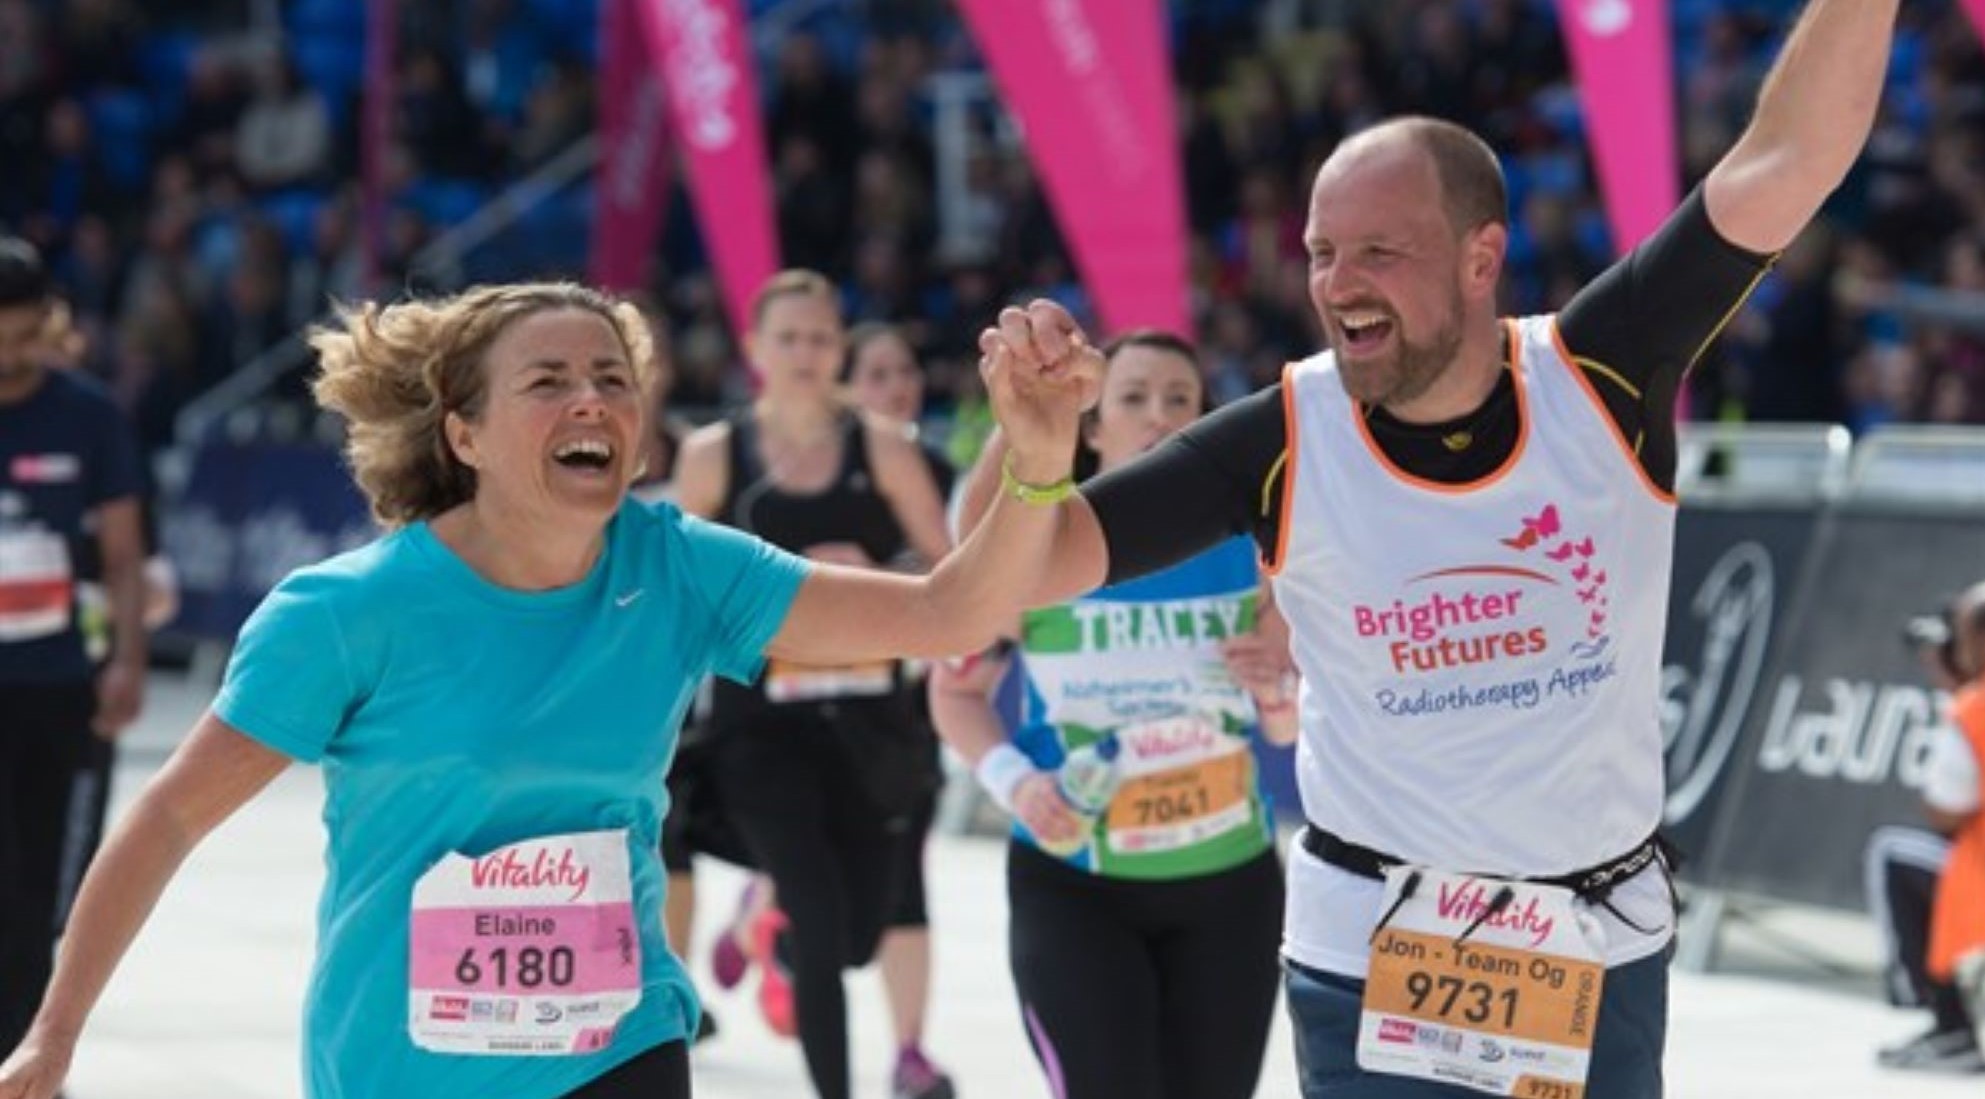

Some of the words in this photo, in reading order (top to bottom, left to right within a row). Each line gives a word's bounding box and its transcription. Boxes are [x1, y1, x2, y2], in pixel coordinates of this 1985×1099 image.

[1071, 600, 1243, 651] TRACEY
[1353, 589, 1523, 641] Brighter
[1390, 627, 1547, 673] Futures
[1375, 678, 1540, 715] Radiotherapy
[1136, 787, 1209, 823] 7041
[470, 848, 590, 902] Vitality
[474, 914, 557, 937] Elaine
[455, 944, 575, 988] 6180
[1378, 933, 1426, 960] Jon
[1452, 943, 1521, 977] Team
[1529, 958, 1567, 988] Og
[1407, 970, 1520, 1029] 9731
